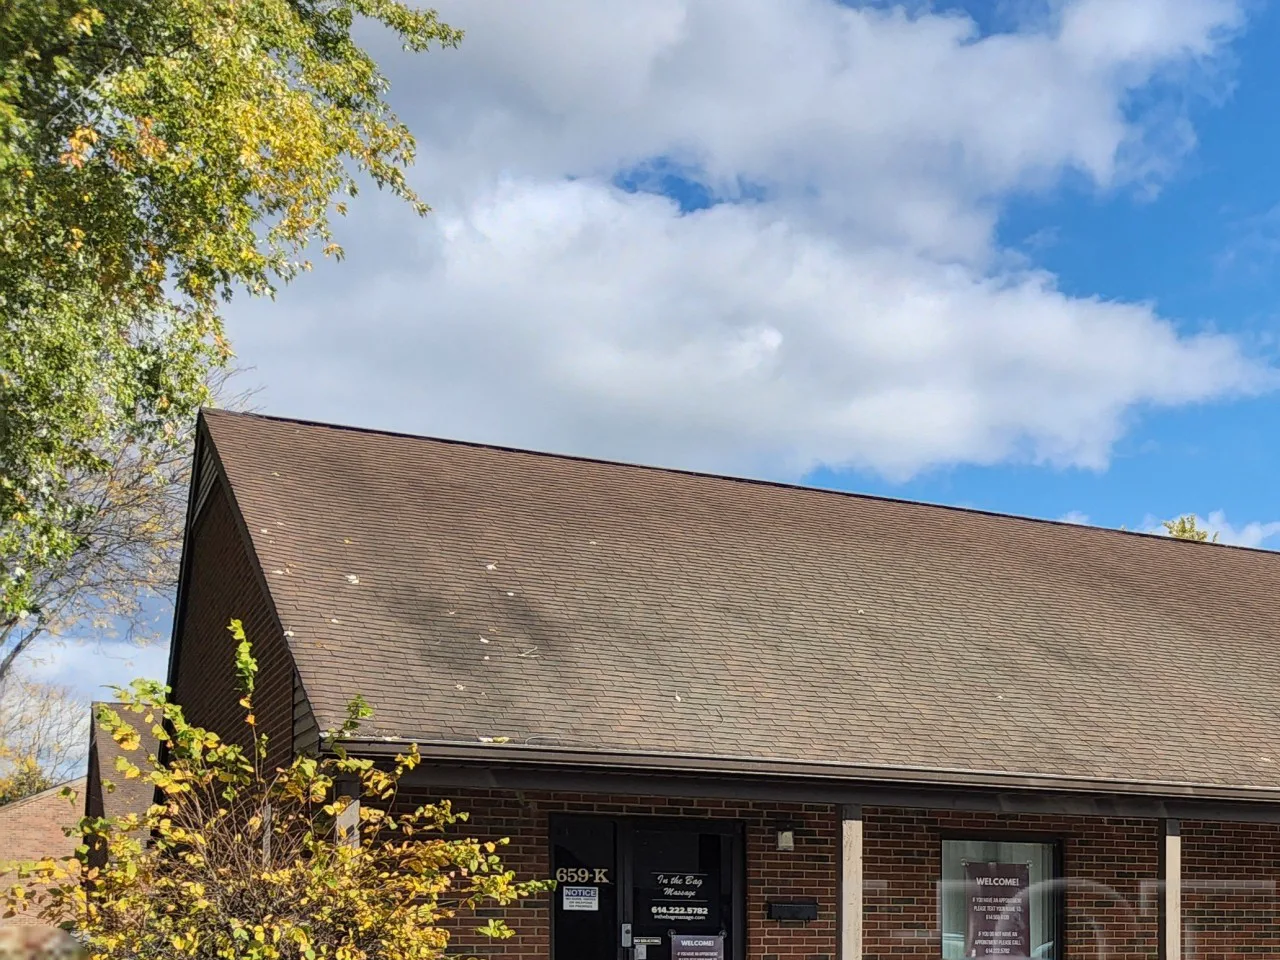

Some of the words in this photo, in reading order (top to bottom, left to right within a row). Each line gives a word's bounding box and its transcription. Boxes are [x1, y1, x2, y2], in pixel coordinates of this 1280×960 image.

[556, 868, 609, 883] 659-K
[657, 875, 668, 884] In
[670, 875, 683, 885] the
[685, 875, 703, 888] Bag
[976, 877, 1020, 886] WELCOME!
[565, 889, 597, 897] NOTICE
[663, 887, 696, 898] Massage
[651, 905, 709, 915] 614.222.5782
